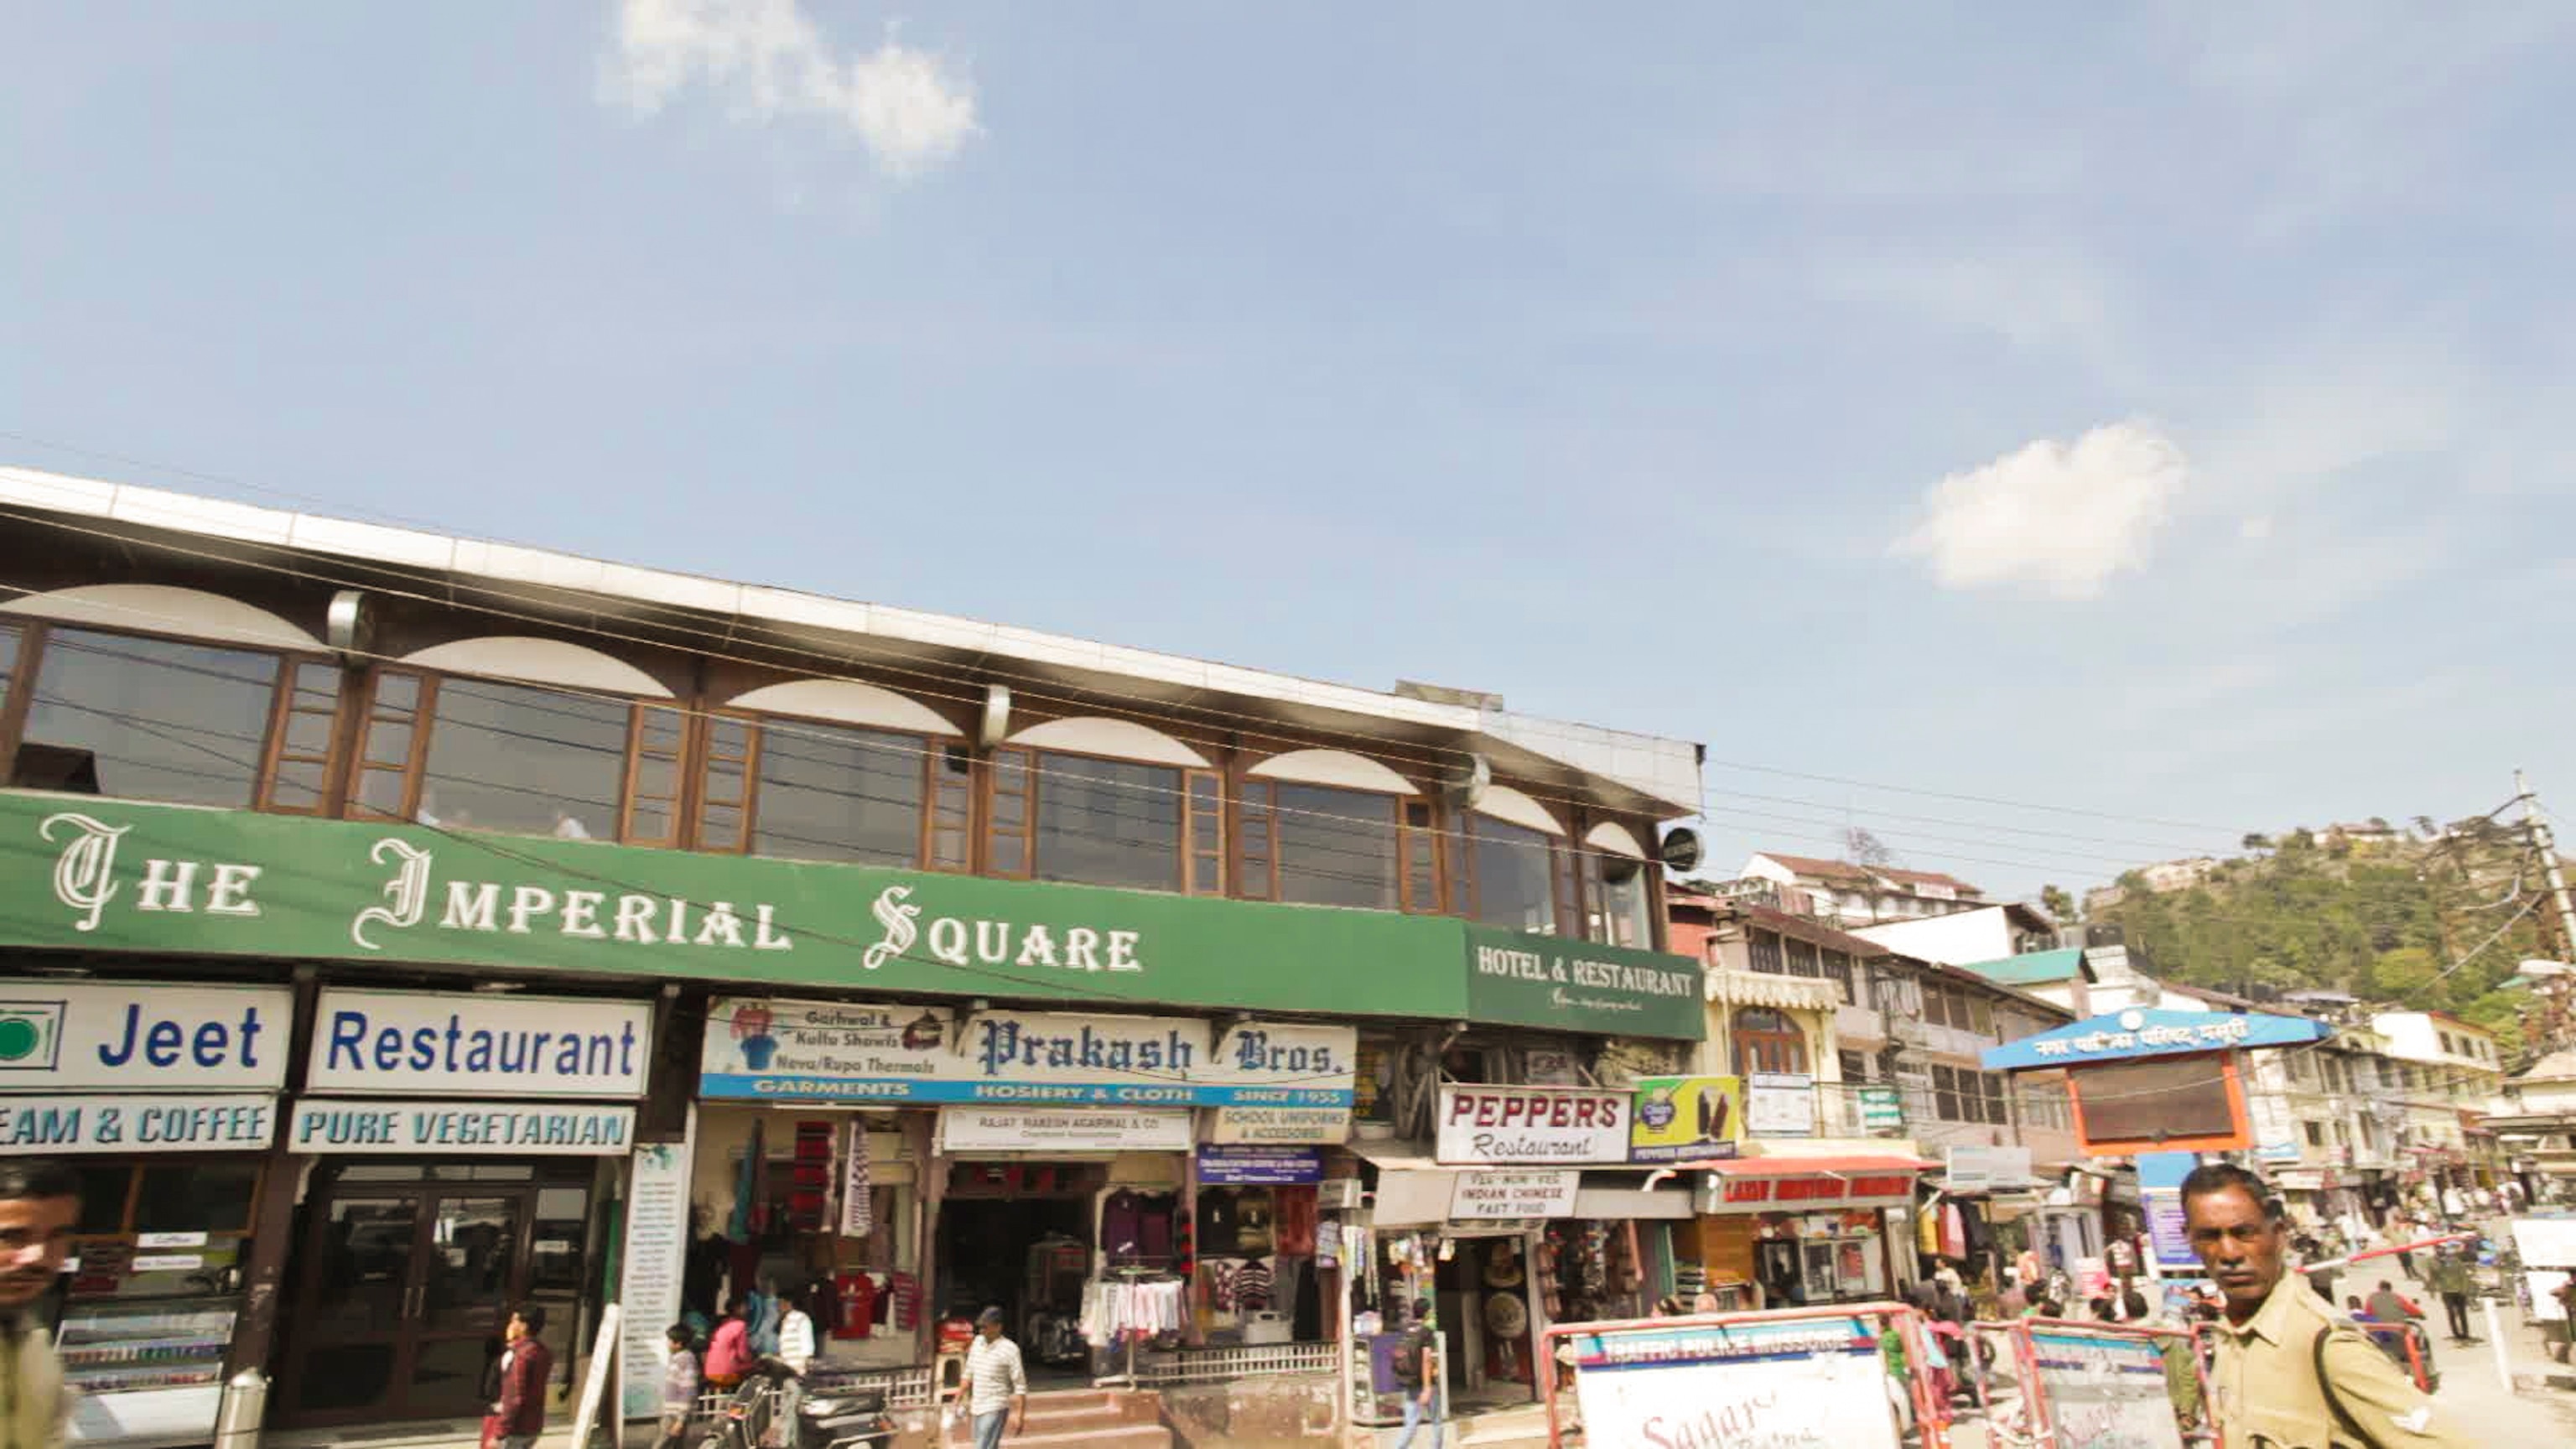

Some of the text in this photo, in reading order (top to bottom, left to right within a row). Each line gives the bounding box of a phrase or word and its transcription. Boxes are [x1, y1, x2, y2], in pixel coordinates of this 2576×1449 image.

[39, 813, 1142, 972] THE IMPERIAL SQUARE
[1478, 946, 1693, 997] HOTEL & RESTAURANT
[804, 1010, 875, 1026] Garhwal
[98, 1003, 636, 1077] Jeet Restaurant
[979, 1019, 1344, 1077] Prakash Bros.
[753, 1079, 911, 1096] GARMENTS
[1118, 1088, 1193, 1102] CLOTH
[94, 1108, 123, 1144] &
[137, 1105, 267, 1143] COFFEE
[299, 1108, 628, 1147] PURE VEGETARIAN
[1449, 1093, 1620, 1128] PEPPERS
[1472, 1133, 1593, 1156] Restaurant
